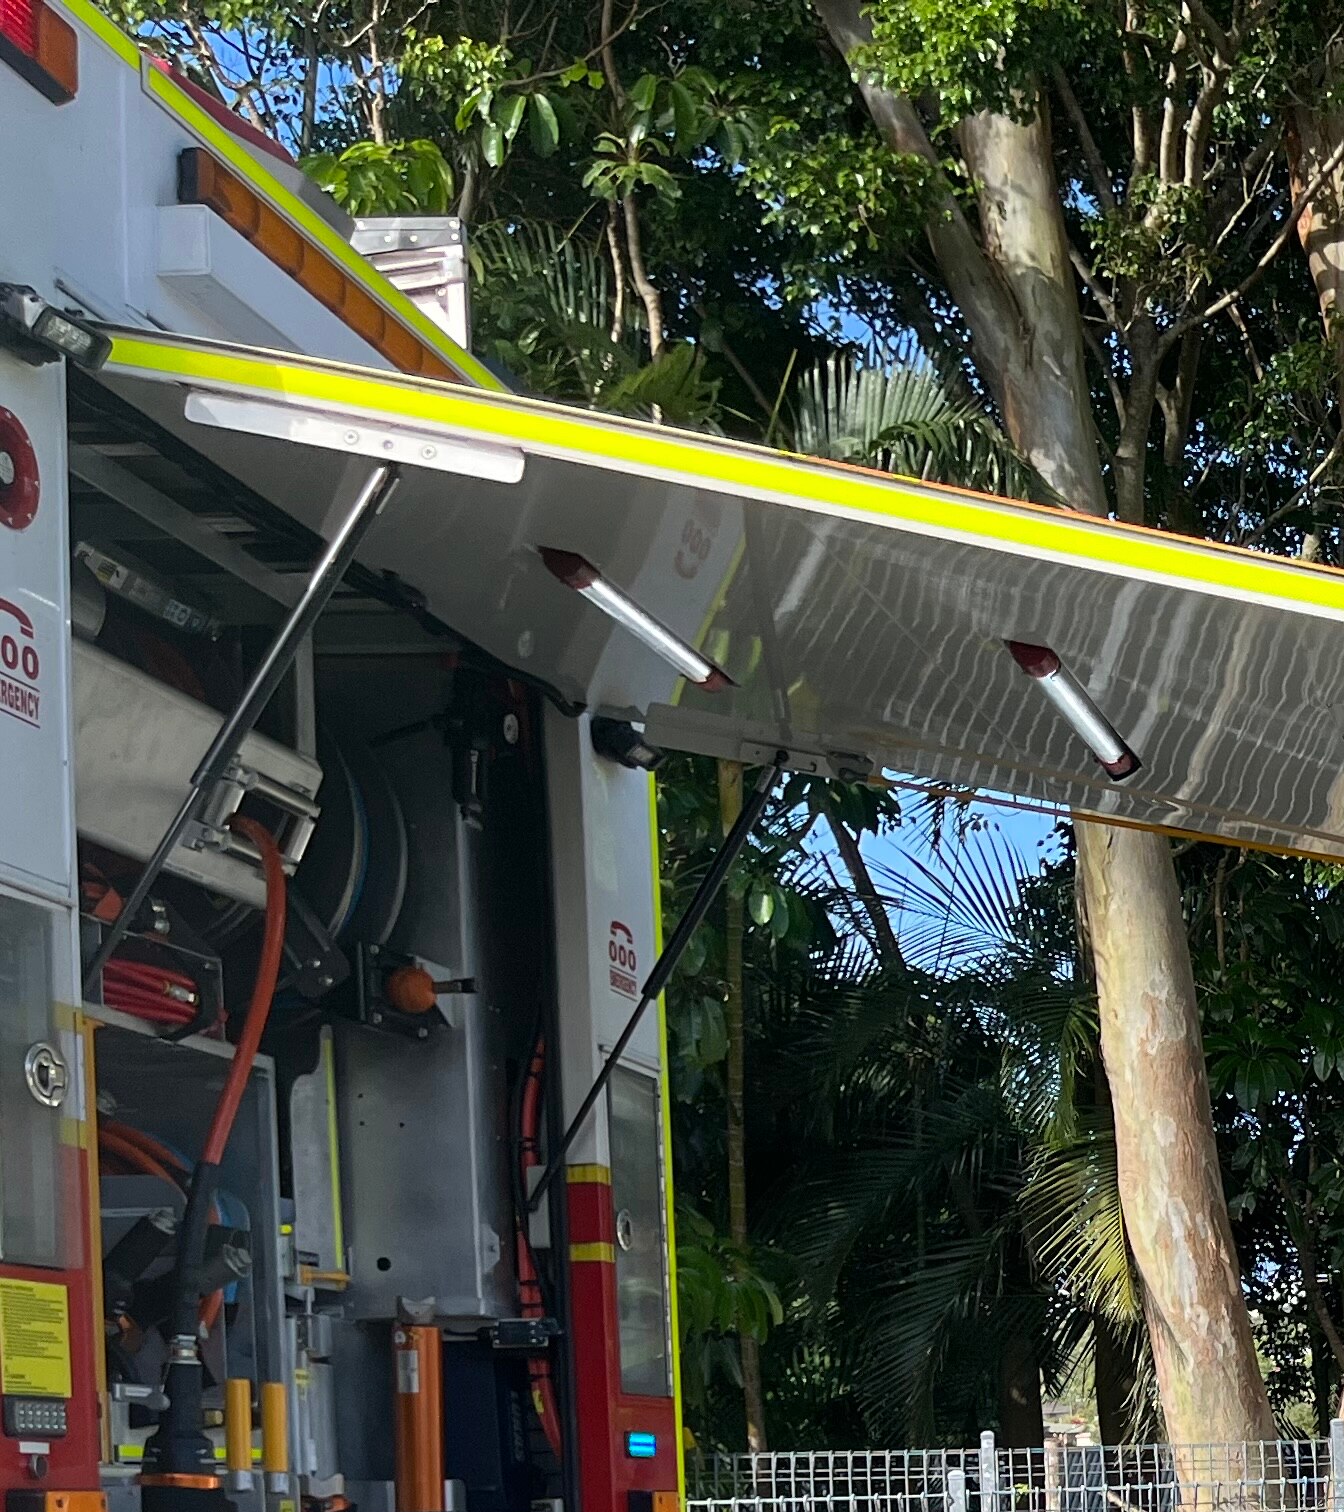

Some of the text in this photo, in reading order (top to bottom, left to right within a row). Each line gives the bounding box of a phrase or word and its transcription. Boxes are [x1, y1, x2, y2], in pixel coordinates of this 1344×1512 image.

[0, 634, 39, 680] 00
[0, 679, 39, 720] RGENCY
[608, 940, 636, 972] 000
